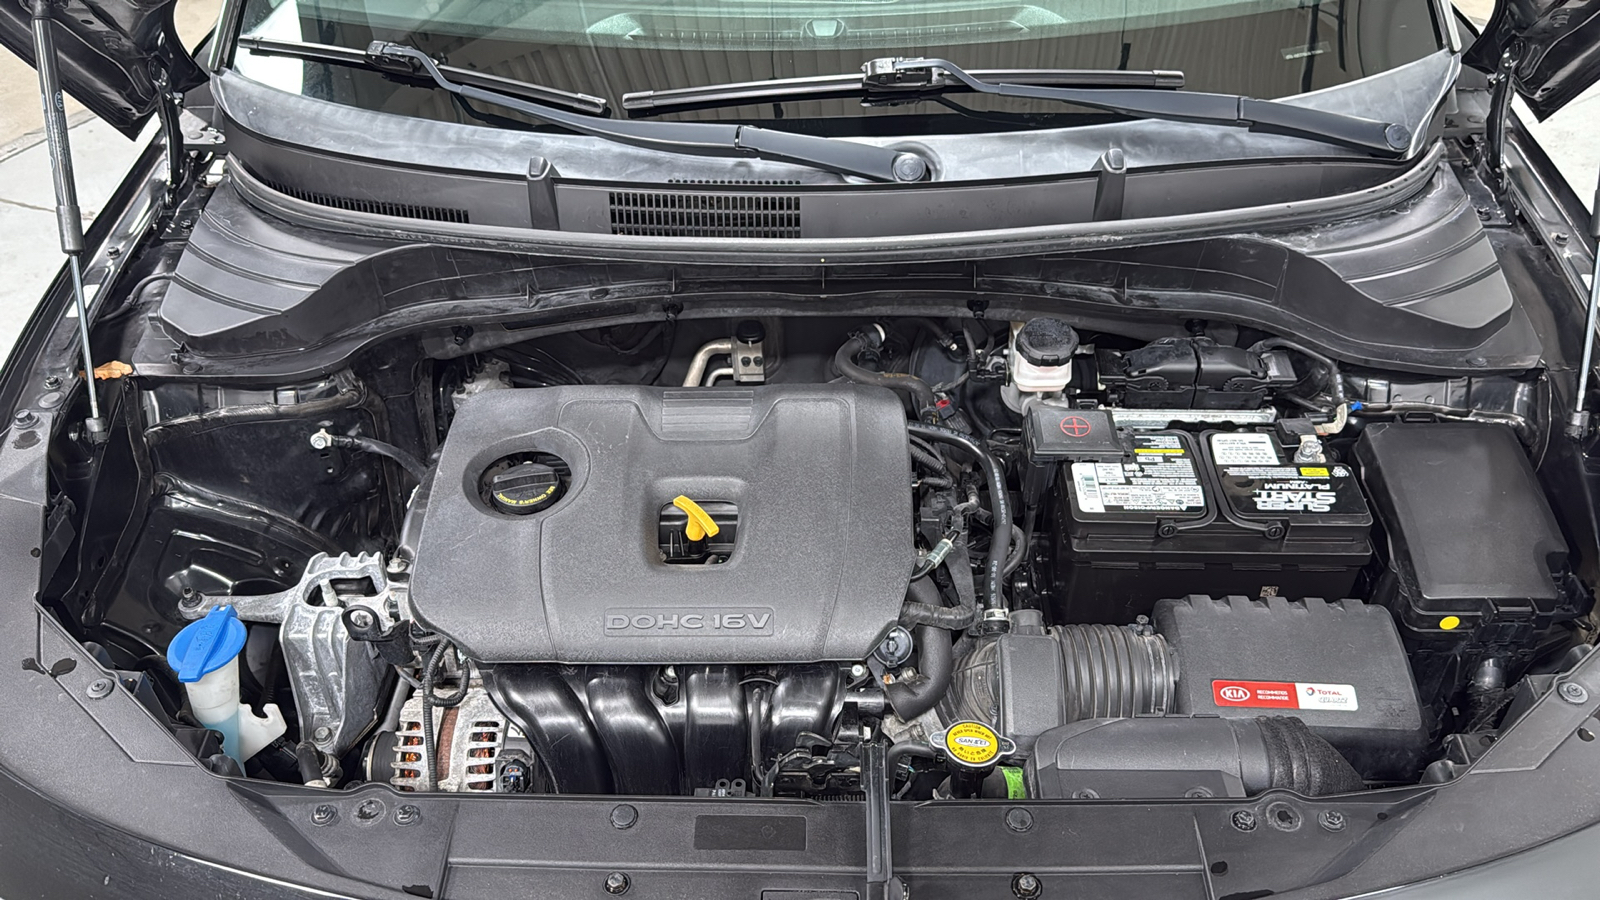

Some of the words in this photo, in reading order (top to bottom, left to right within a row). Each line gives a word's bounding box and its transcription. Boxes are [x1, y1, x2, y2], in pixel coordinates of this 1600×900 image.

[1255, 491, 1337, 504] START
[1256, 501, 1331, 512] SUPER
[606, 614, 704, 630] DOHC
[713, 613, 771, 630] 16V
[1224, 689, 1246, 699] KIA
